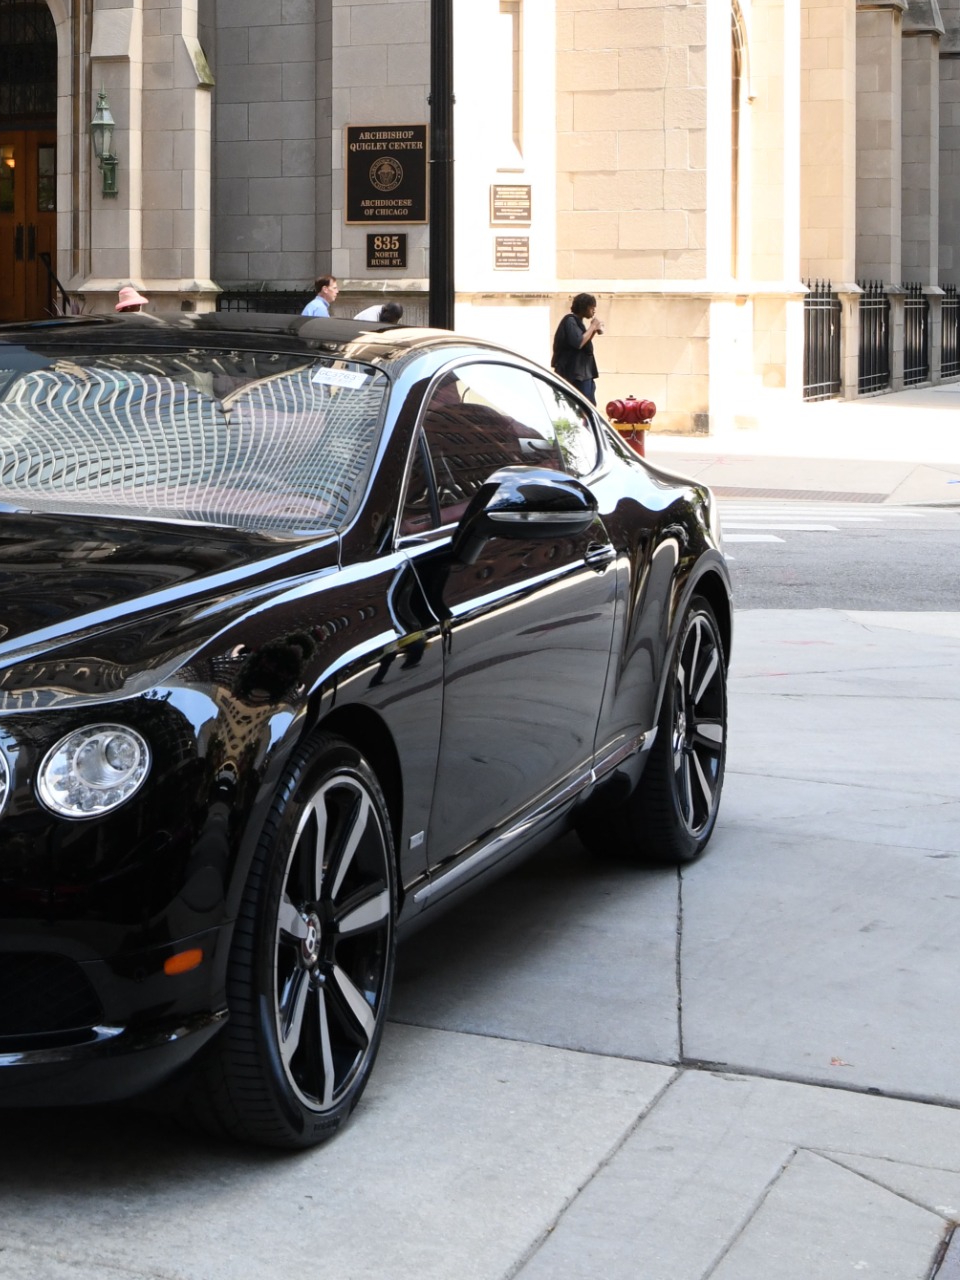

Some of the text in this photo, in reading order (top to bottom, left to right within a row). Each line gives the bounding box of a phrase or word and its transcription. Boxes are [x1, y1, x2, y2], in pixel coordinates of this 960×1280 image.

[359, 131, 414, 140] ARCHBISHOP
[349, 141, 423, 152] QUIGLEY CENTER
[360, 199, 413, 207] ARCHDIOCESE
[364, 208, 409, 216] OF CHICAGO
[374, 236, 400, 250] 835
[371, 258, 403, 266] RUSH ST.
